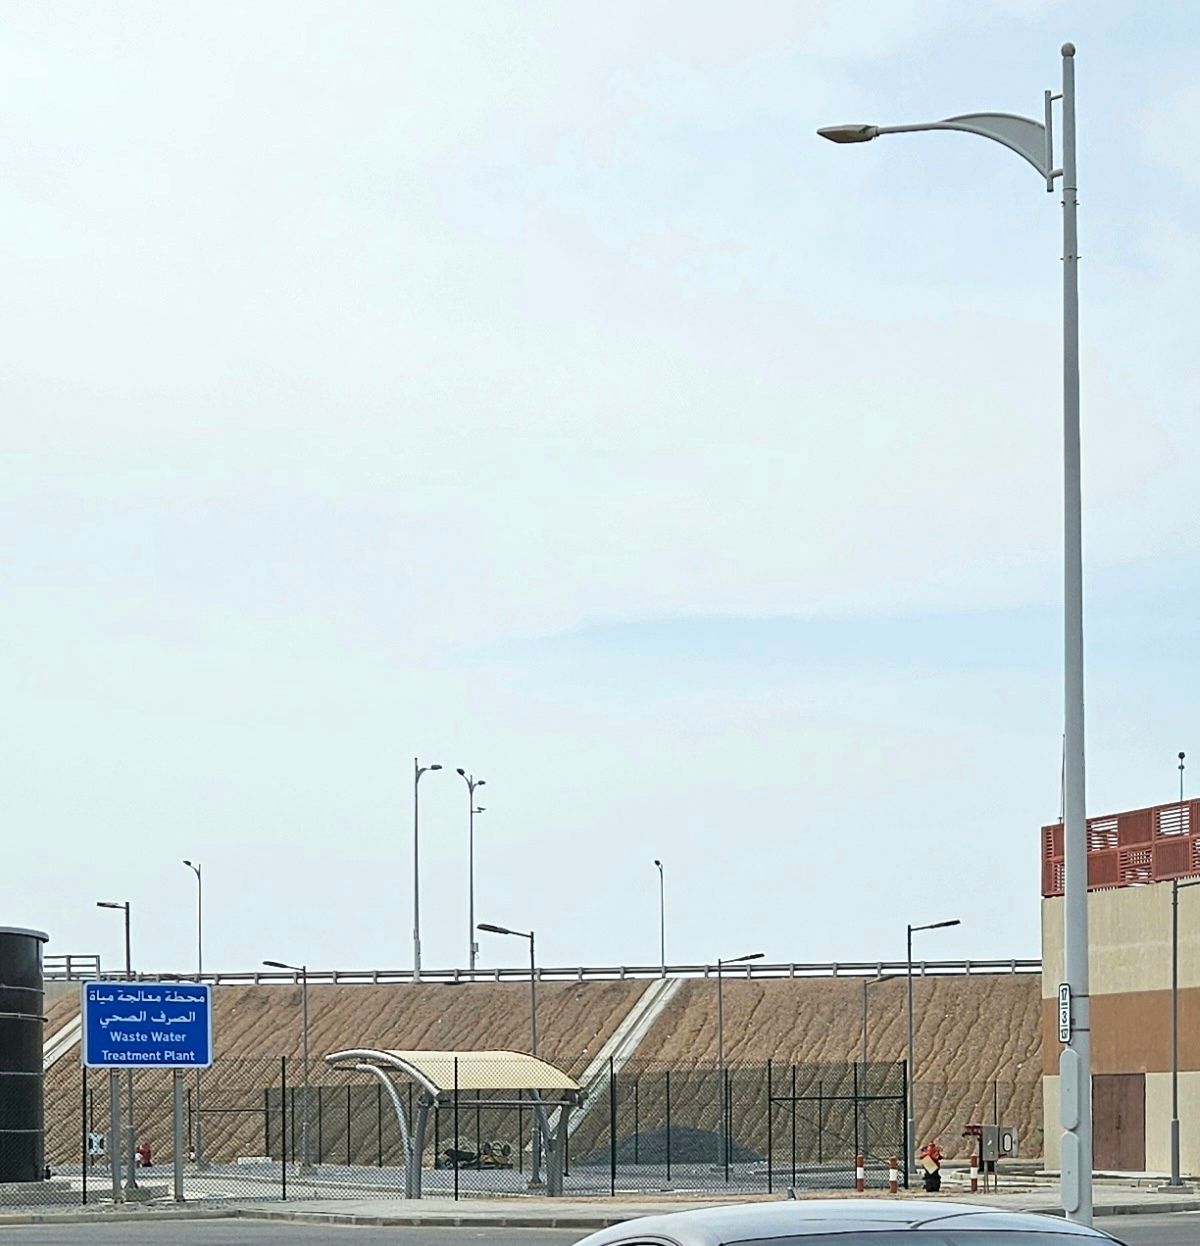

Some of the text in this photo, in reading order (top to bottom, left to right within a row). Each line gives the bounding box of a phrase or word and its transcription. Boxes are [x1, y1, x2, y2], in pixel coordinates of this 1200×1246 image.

[151, 1011, 195, 1025] الصرف
[110, 1032, 186, 1041] Waste Water
[102, 1050, 195, 1060] Treatment Plant
